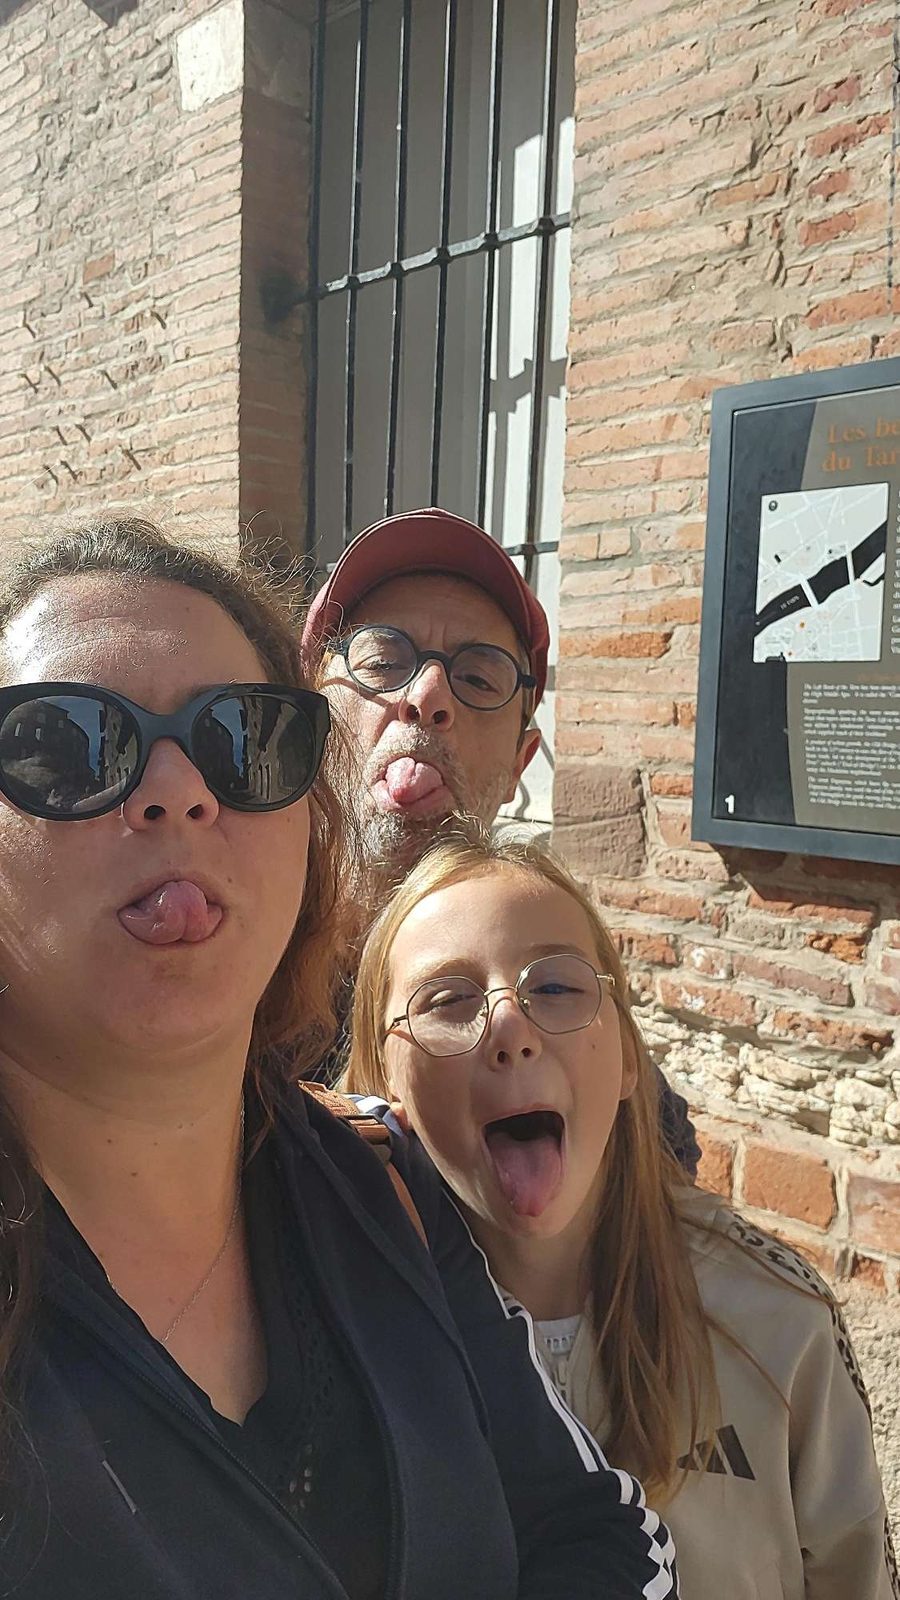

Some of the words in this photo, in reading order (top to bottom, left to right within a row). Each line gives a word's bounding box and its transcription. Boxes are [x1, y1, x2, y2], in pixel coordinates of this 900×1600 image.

[828, 424, 866, 443] Les
[822, 450, 852, 472] du
[724, 794, 735, 814] 1
